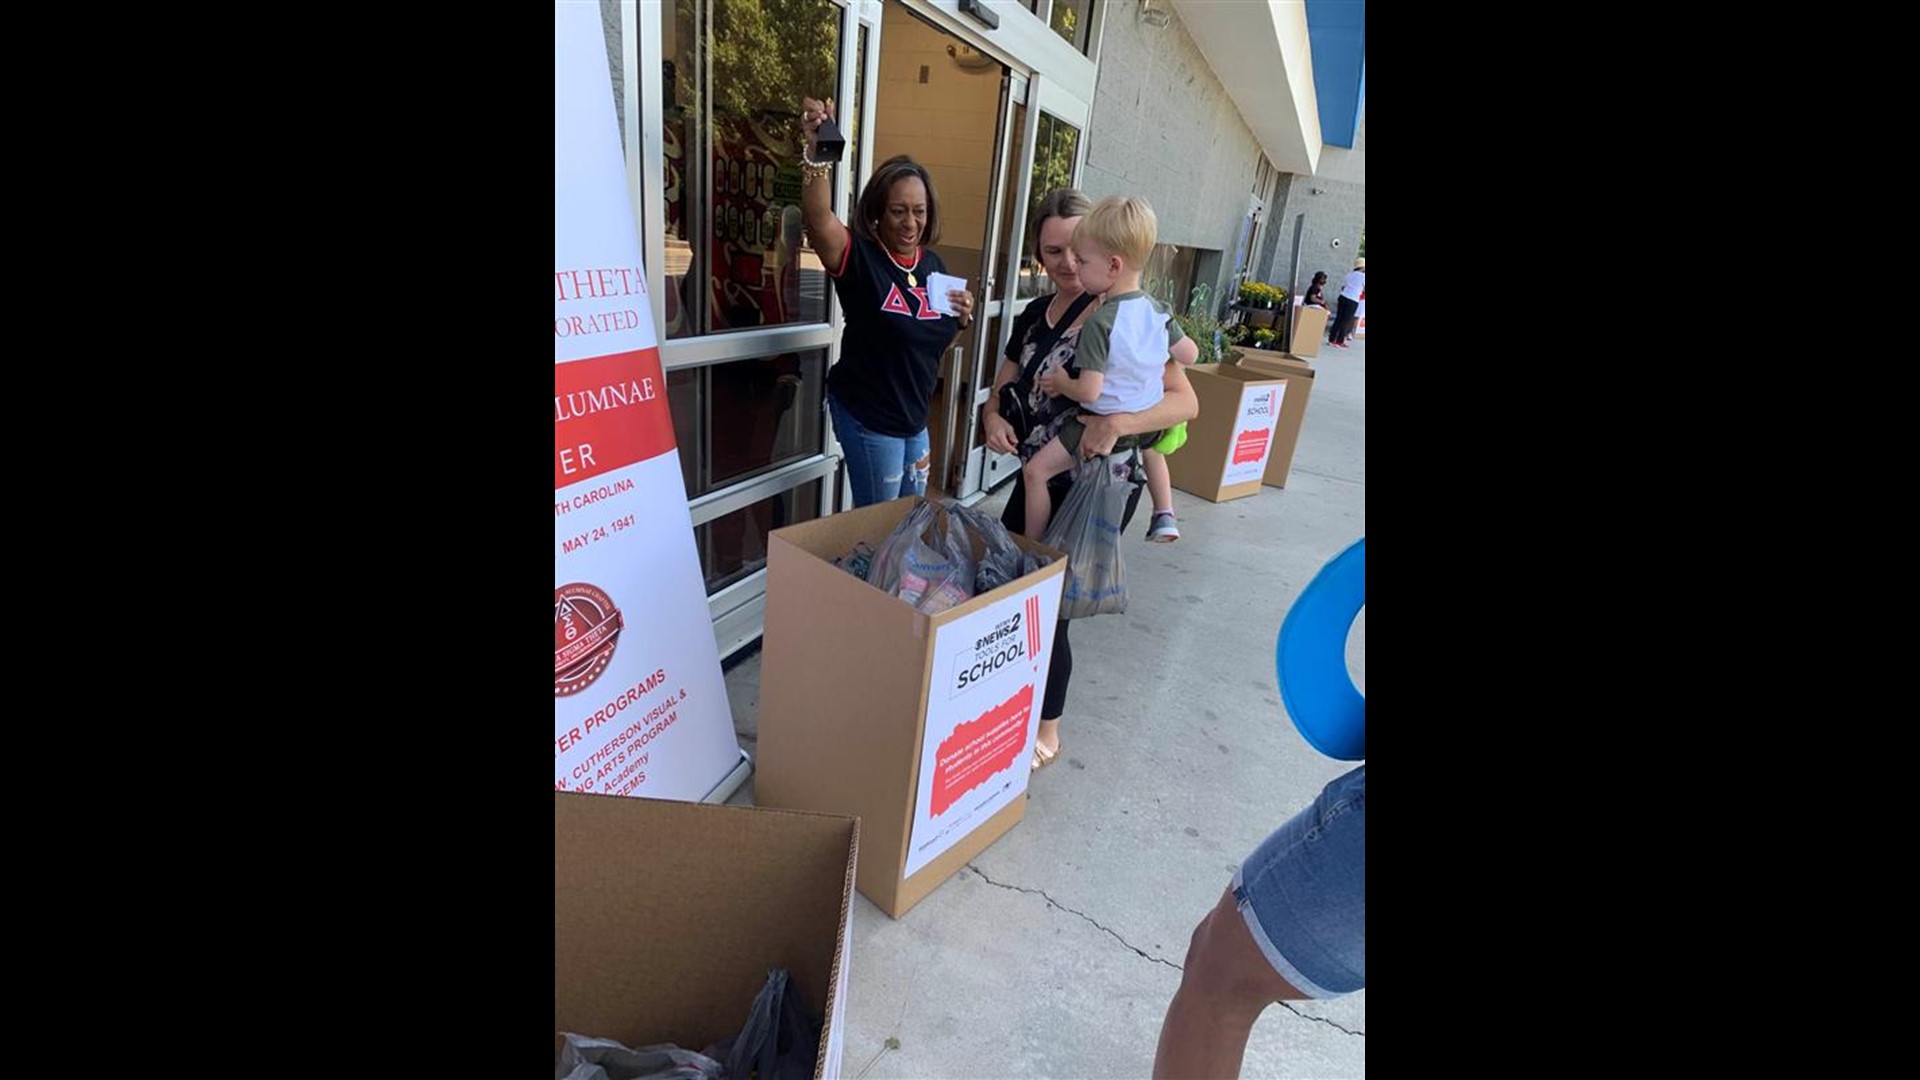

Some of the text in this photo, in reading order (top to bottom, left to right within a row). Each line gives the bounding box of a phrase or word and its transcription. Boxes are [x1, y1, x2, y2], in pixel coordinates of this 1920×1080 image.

[555, 266, 647, 301] THETA
[555, 310, 639, 338] ORATED
[555, 377, 656, 422] LUMNAE
[559, 443, 596, 474] ER
[573, 478, 635, 509] CAROLINA
[562, 514, 636, 554] MAY 24, 1941
[1001, 634, 1017, 648] FOR
[957, 640, 1025, 689] SCHOOL
[555, 669, 666, 758] ER PROGRAMS
[573, 721, 641, 779] CUTHERSON
[642, 696, 678, 725] VISUAL
[679, 688, 687, 700] &
[596, 752, 626, 781] ARTS
[627, 711, 678, 757] PROGRAM
[604, 752, 649, 794] Academy
[940, 748, 964, 767] Donate
[616, 771, 646, 796] GEMS
